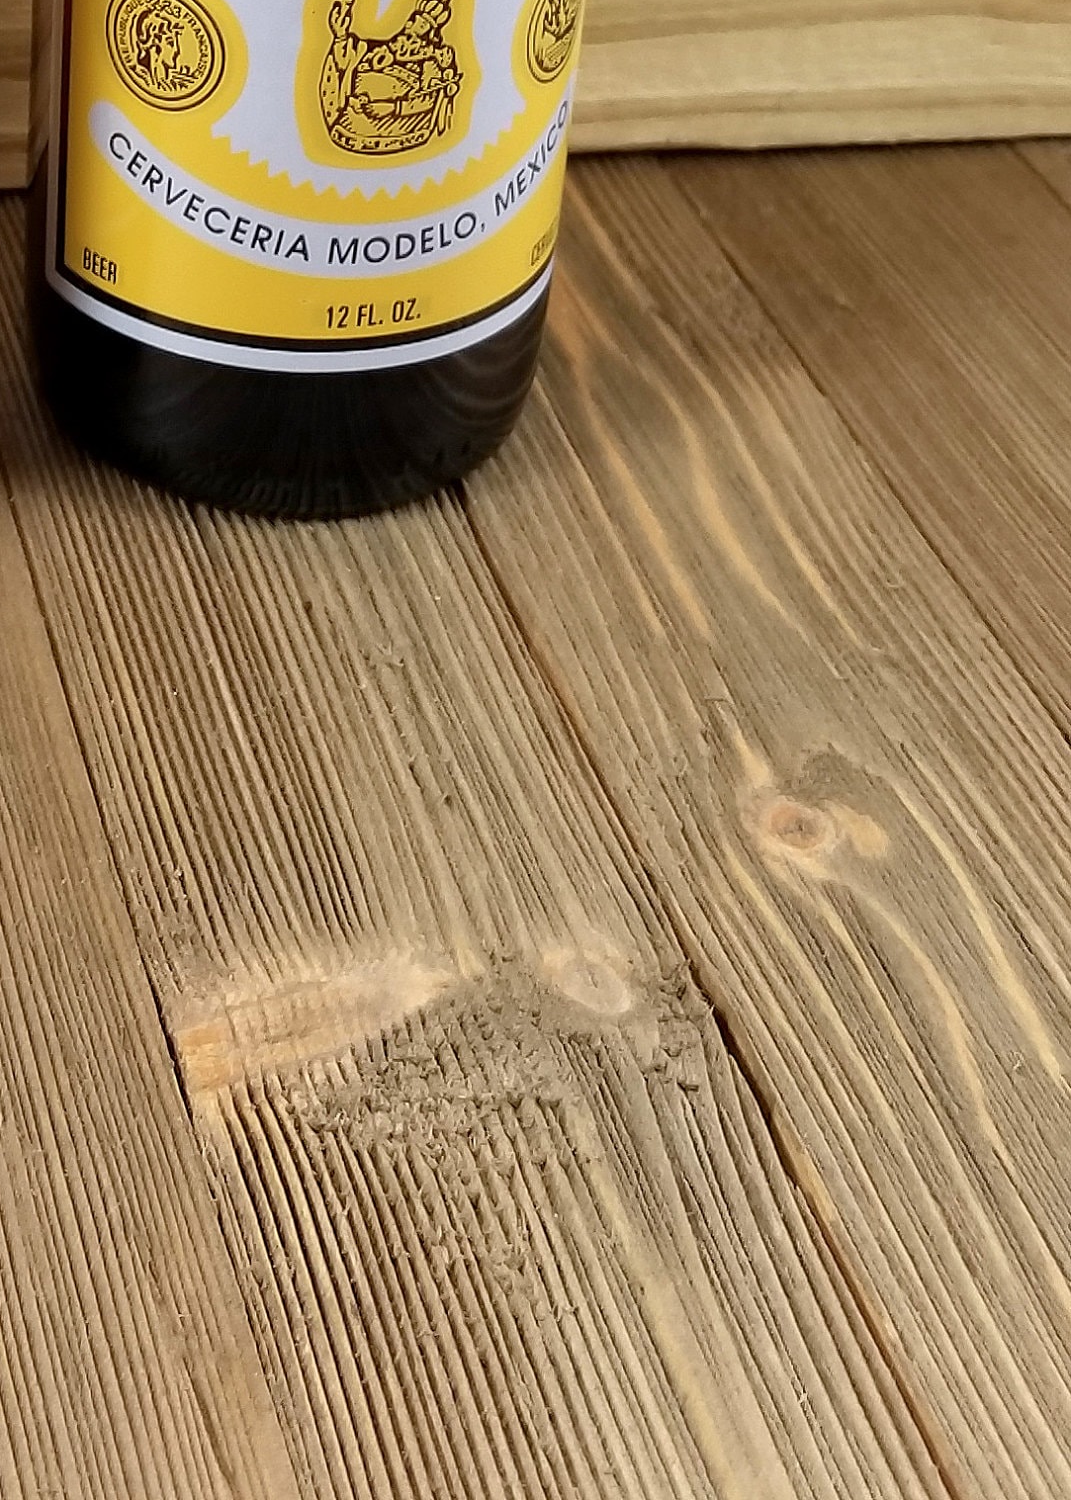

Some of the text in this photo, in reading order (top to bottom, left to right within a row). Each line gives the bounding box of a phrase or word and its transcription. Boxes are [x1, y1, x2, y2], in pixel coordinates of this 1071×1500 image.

[108, 134, 310, 262] CERVECERIA
[328, 213, 486, 265] MODELO,
[494, 99, 569, 217] MEXICO
[82, 246, 118, 286] BEER
[327, 297, 421, 329] 12 FL. OZ.
